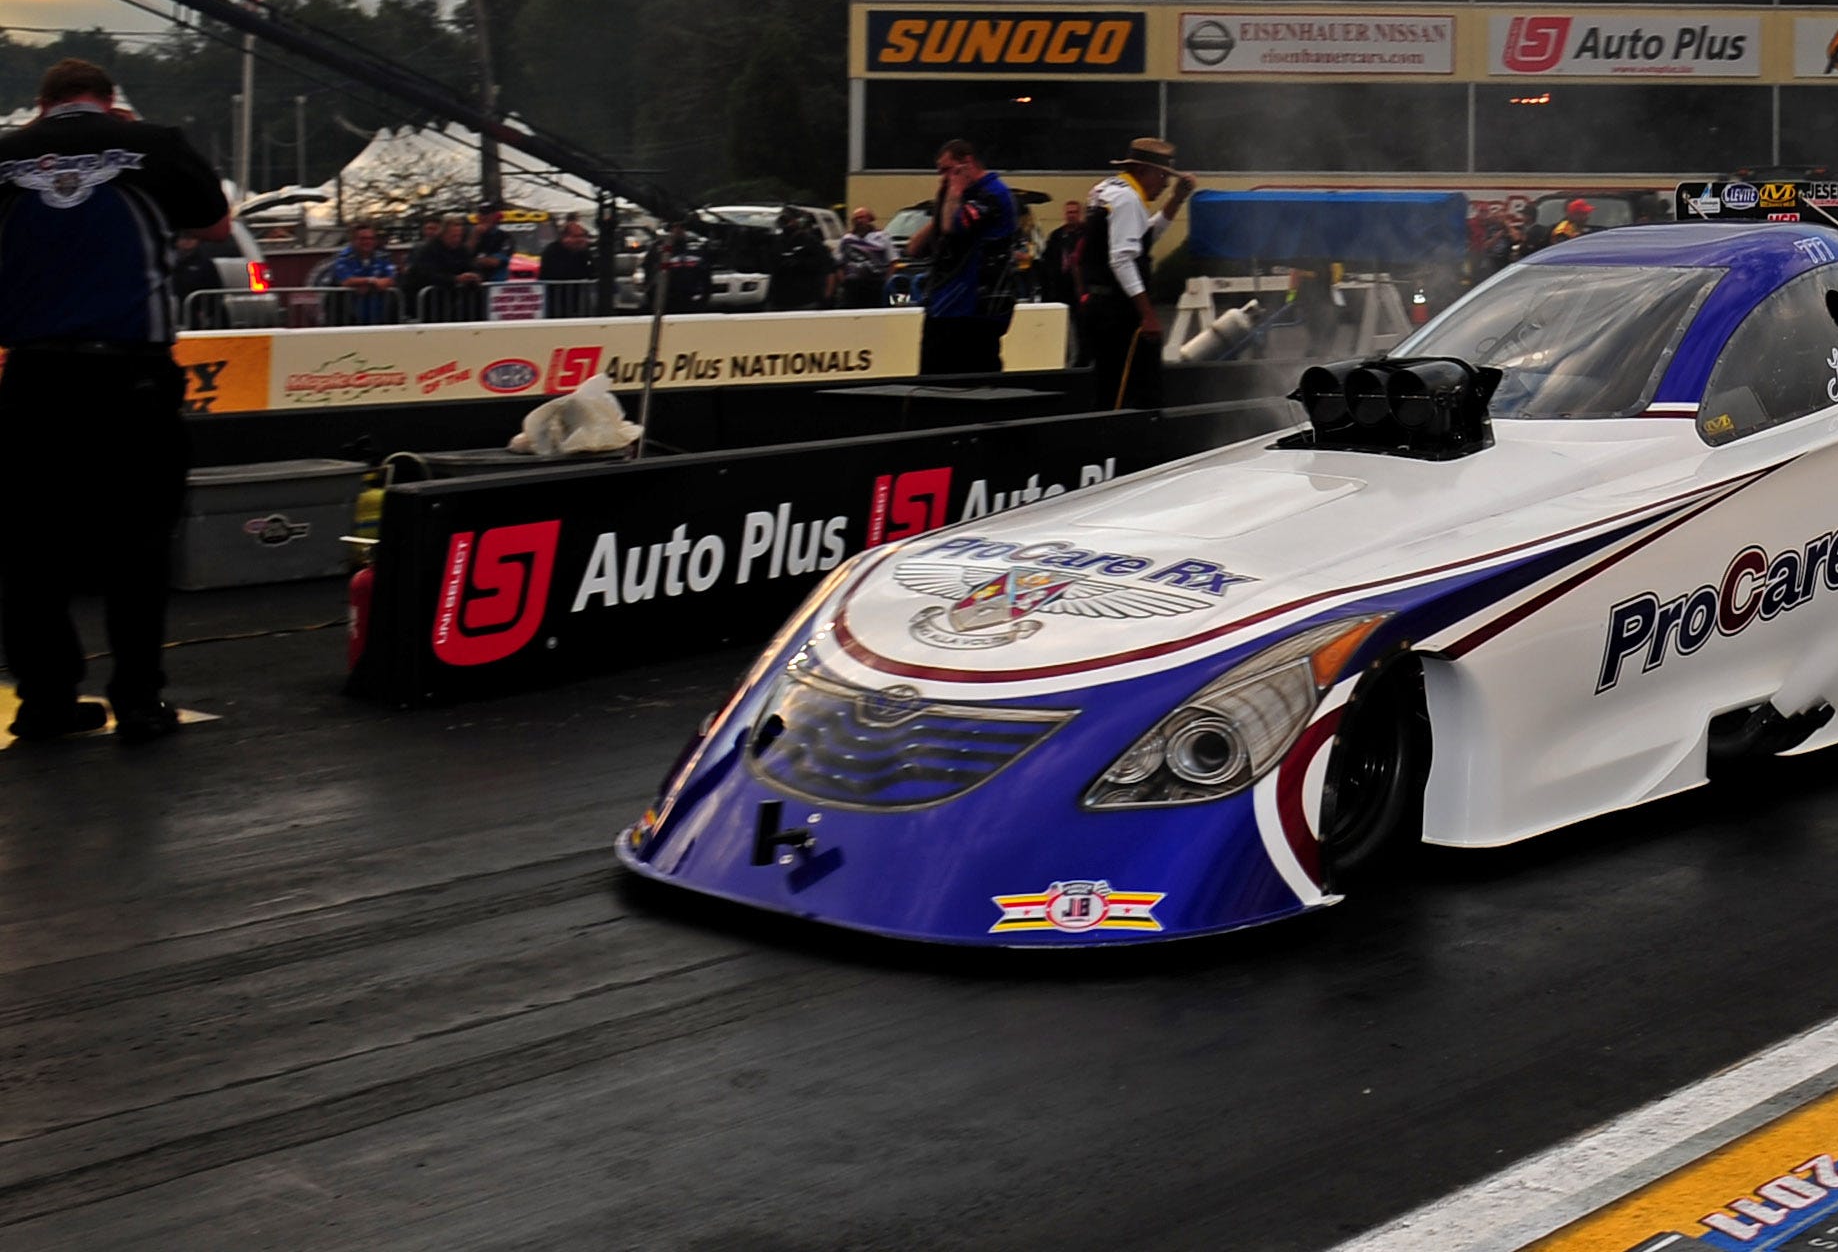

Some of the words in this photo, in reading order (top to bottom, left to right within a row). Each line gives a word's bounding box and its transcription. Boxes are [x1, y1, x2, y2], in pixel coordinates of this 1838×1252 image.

[878, 19, 1134, 65] SUNOCO
[1238, 22, 1370, 42] EISENHAUER
[1373, 24, 1447, 44] NISSAN
[1572, 26, 1666, 60] Auto
[1672, 25, 1748, 61] Plus
[670, 351, 723, 382] Plus
[728, 348, 872, 379] NATIONALS
[570, 523, 726, 613] Auto
[735, 502, 849, 586] Plus
[908, 536, 1154, 577] ProCare
[1144, 557, 1263, 598] Rx
